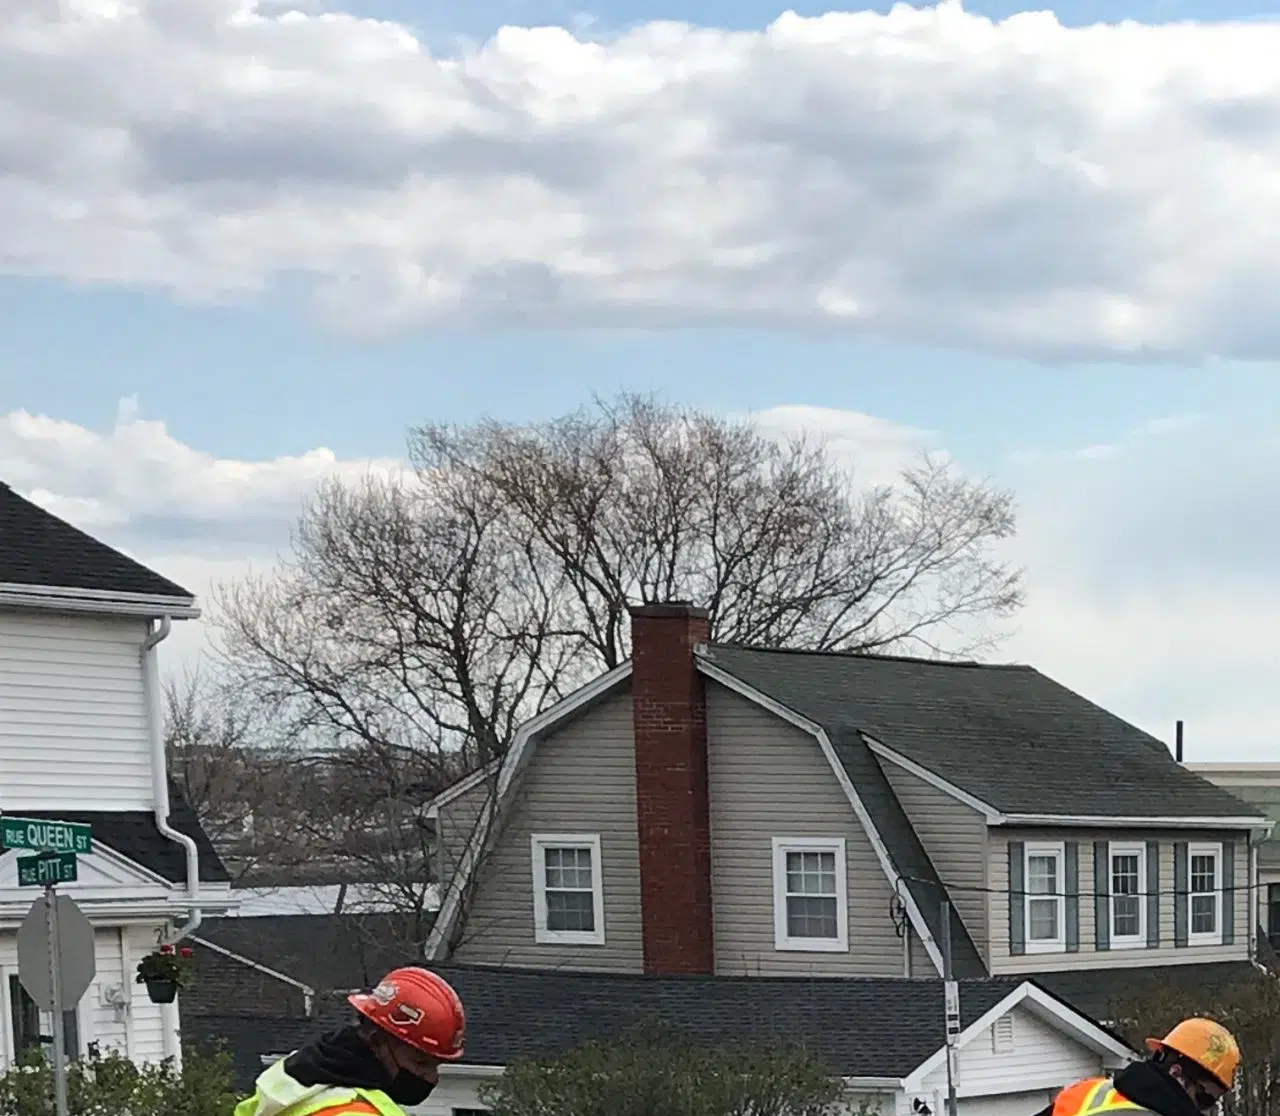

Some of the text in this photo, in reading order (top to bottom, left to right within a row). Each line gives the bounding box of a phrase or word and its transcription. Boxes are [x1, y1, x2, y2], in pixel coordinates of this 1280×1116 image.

[5, 824, 87, 849] RUE QUEEN ST
[38, 858, 61, 881] PITT
[63, 864, 73, 878] ST
